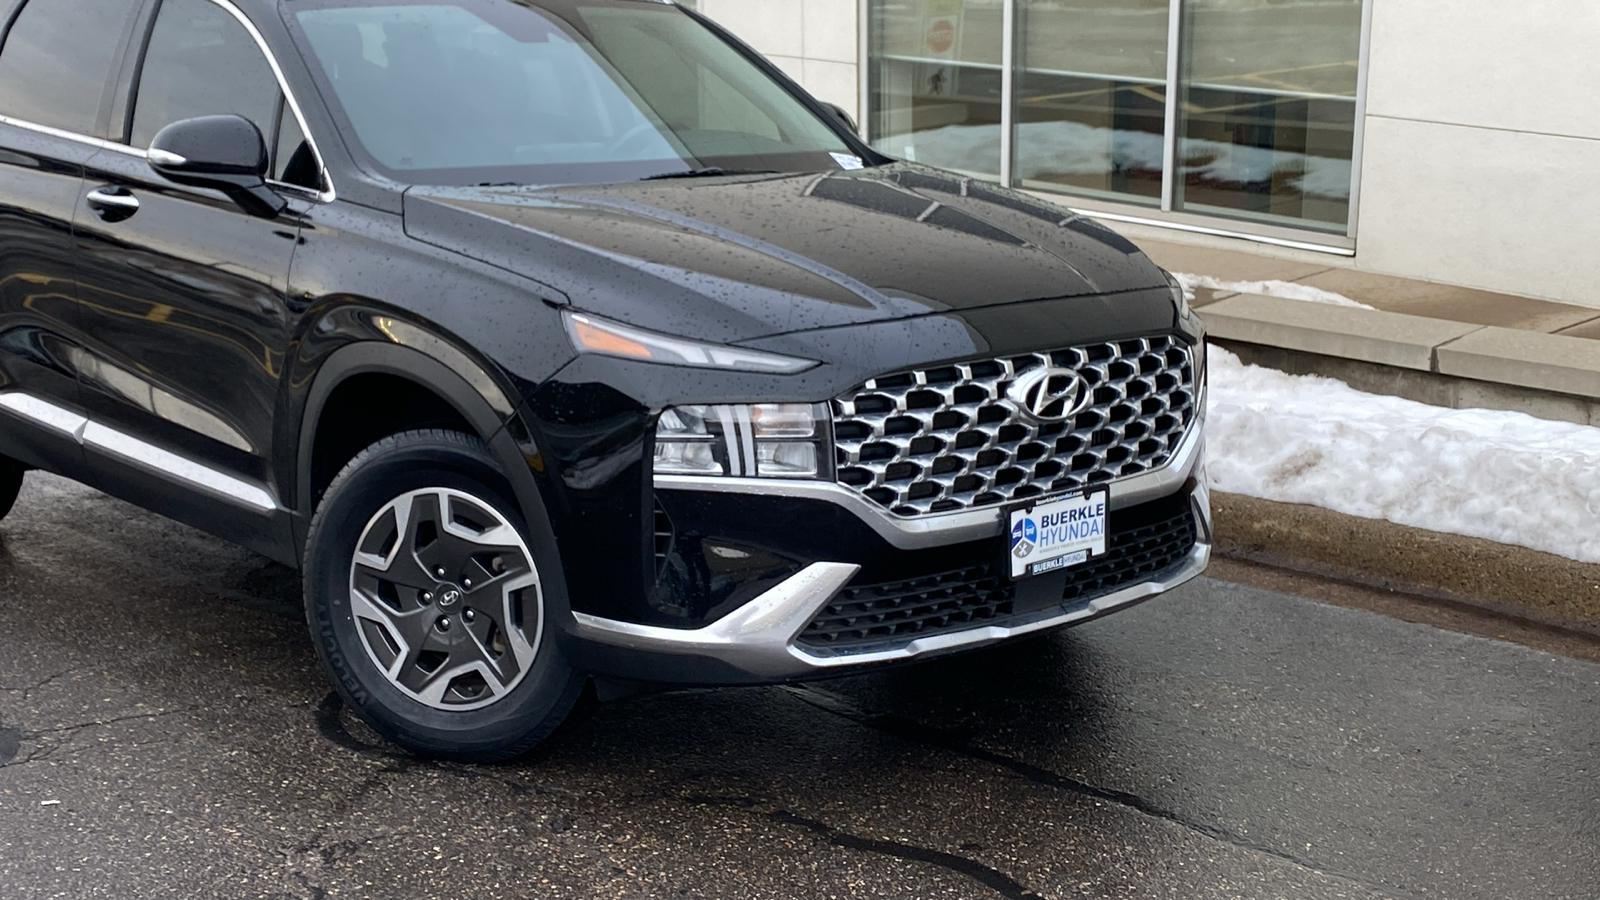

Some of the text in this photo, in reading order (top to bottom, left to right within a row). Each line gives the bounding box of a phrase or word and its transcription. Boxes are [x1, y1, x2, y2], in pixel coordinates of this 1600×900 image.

[1041, 503, 1104, 528] BUERKLE
[1040, 517, 1104, 548] HYUNDAI
[1033, 557, 1063, 573] BUERKLE
